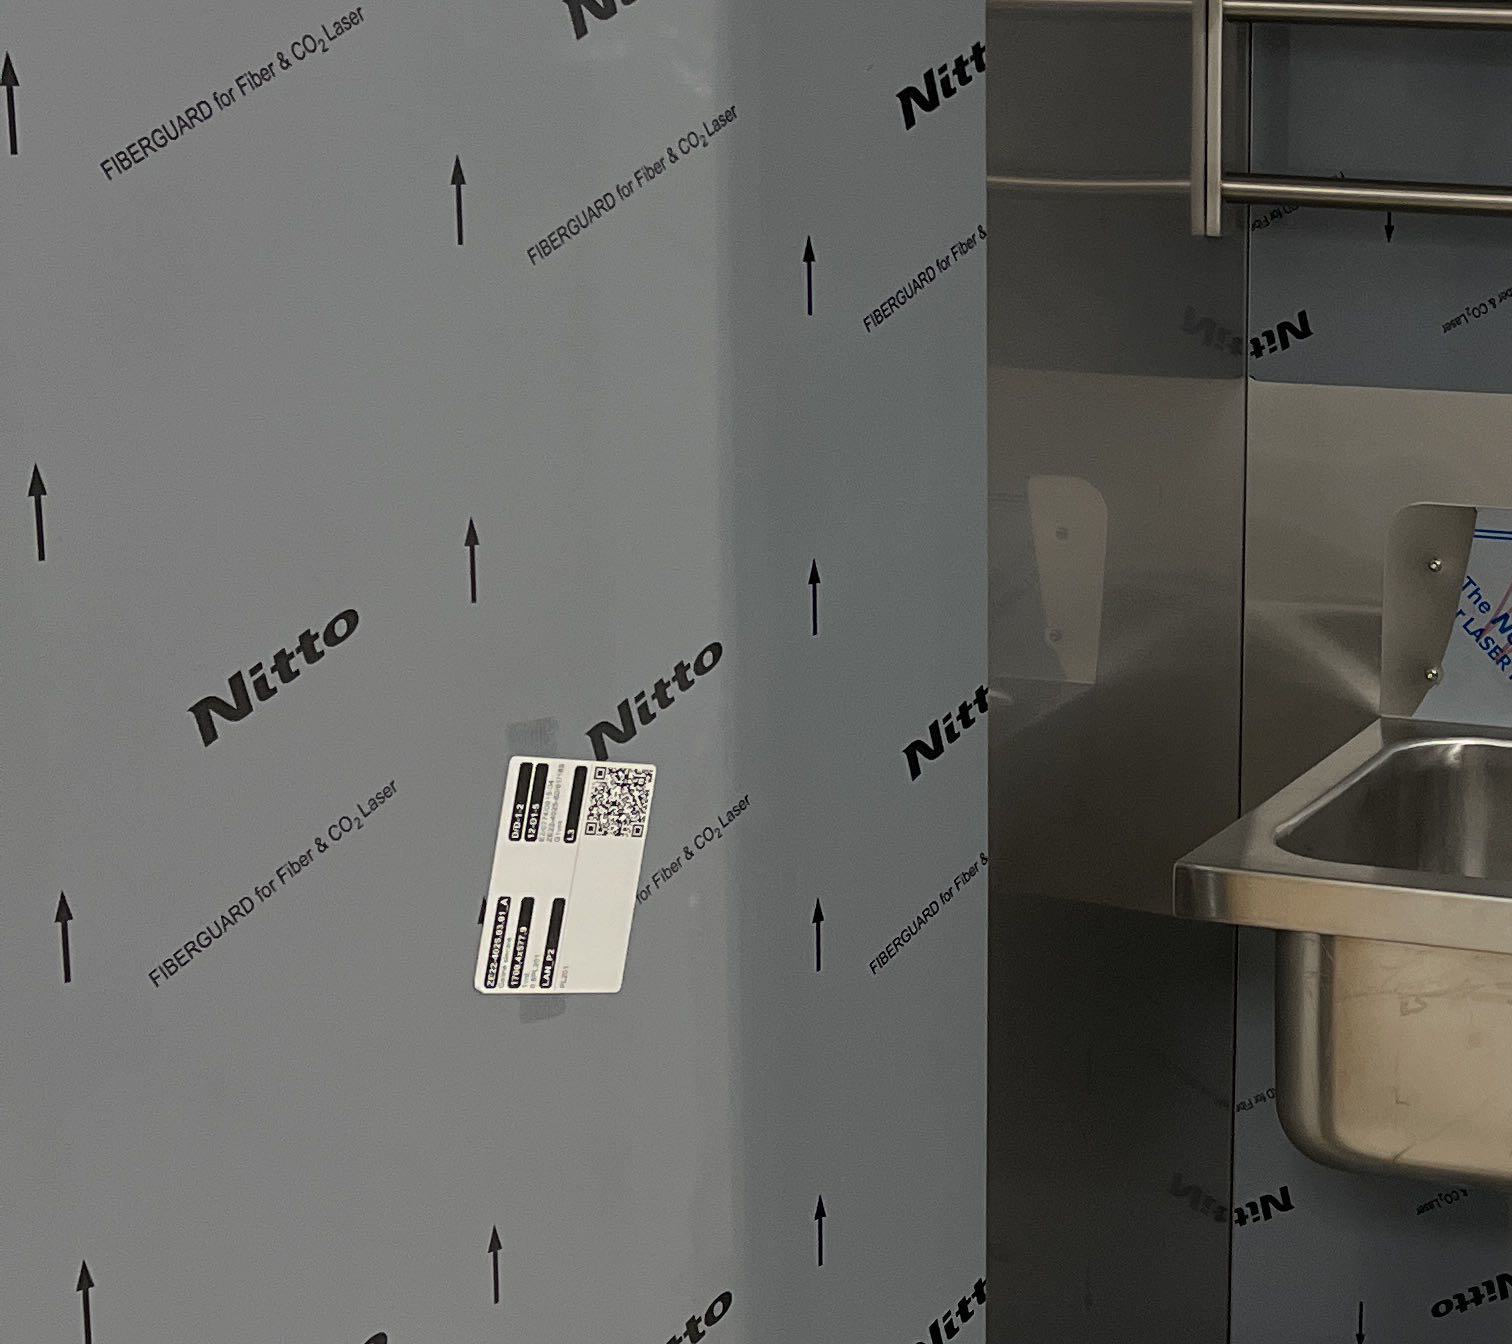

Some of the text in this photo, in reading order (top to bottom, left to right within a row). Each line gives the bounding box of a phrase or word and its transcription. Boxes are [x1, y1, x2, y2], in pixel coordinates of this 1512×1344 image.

[100, 100, 213, 180] FIBERGUARD
[213, 88, 236, 110] for
[235, 62, 275, 96] Fiber
[277, 52, 292, 70] &
[321, 7, 364, 41] Laser
[527, 192, 616, 265] FIBERGUARD
[616, 181, 634, 200] for
[634, 157, 666, 187] Fiber
[667, 147, 679, 164] &
[703, 105, 737, 137] Laser
[863, 225, 987, 333] FIBERGUARD for Fiber &
[1442, 313, 1469, 333] Laser
[1488, 298, 1496, 309] &
[1251, 310, 1313, 358] Nit
[1461, 576, 1491, 614] The
[1462, 617, 1512, 672] LASER
[188, 609, 359, 747] Nitto
[586, 642, 723, 759] Nitto
[148, 897, 254, 988] FIBERGUARD
[255, 880, 276, 902] for
[276, 849, 313, 884] Fiber
[315, 837, 329, 853] &
[357, 780, 397, 818] Laser
[636, 884, 651, 904] for
[652, 856, 682, 889] Fiber
[683, 846, 694, 860] &
[718, 795, 750, 828] Laser
[869, 852, 987, 975] FIBERGUARD for Fiber &
[1235, 1186, 1294, 1226] Nit
